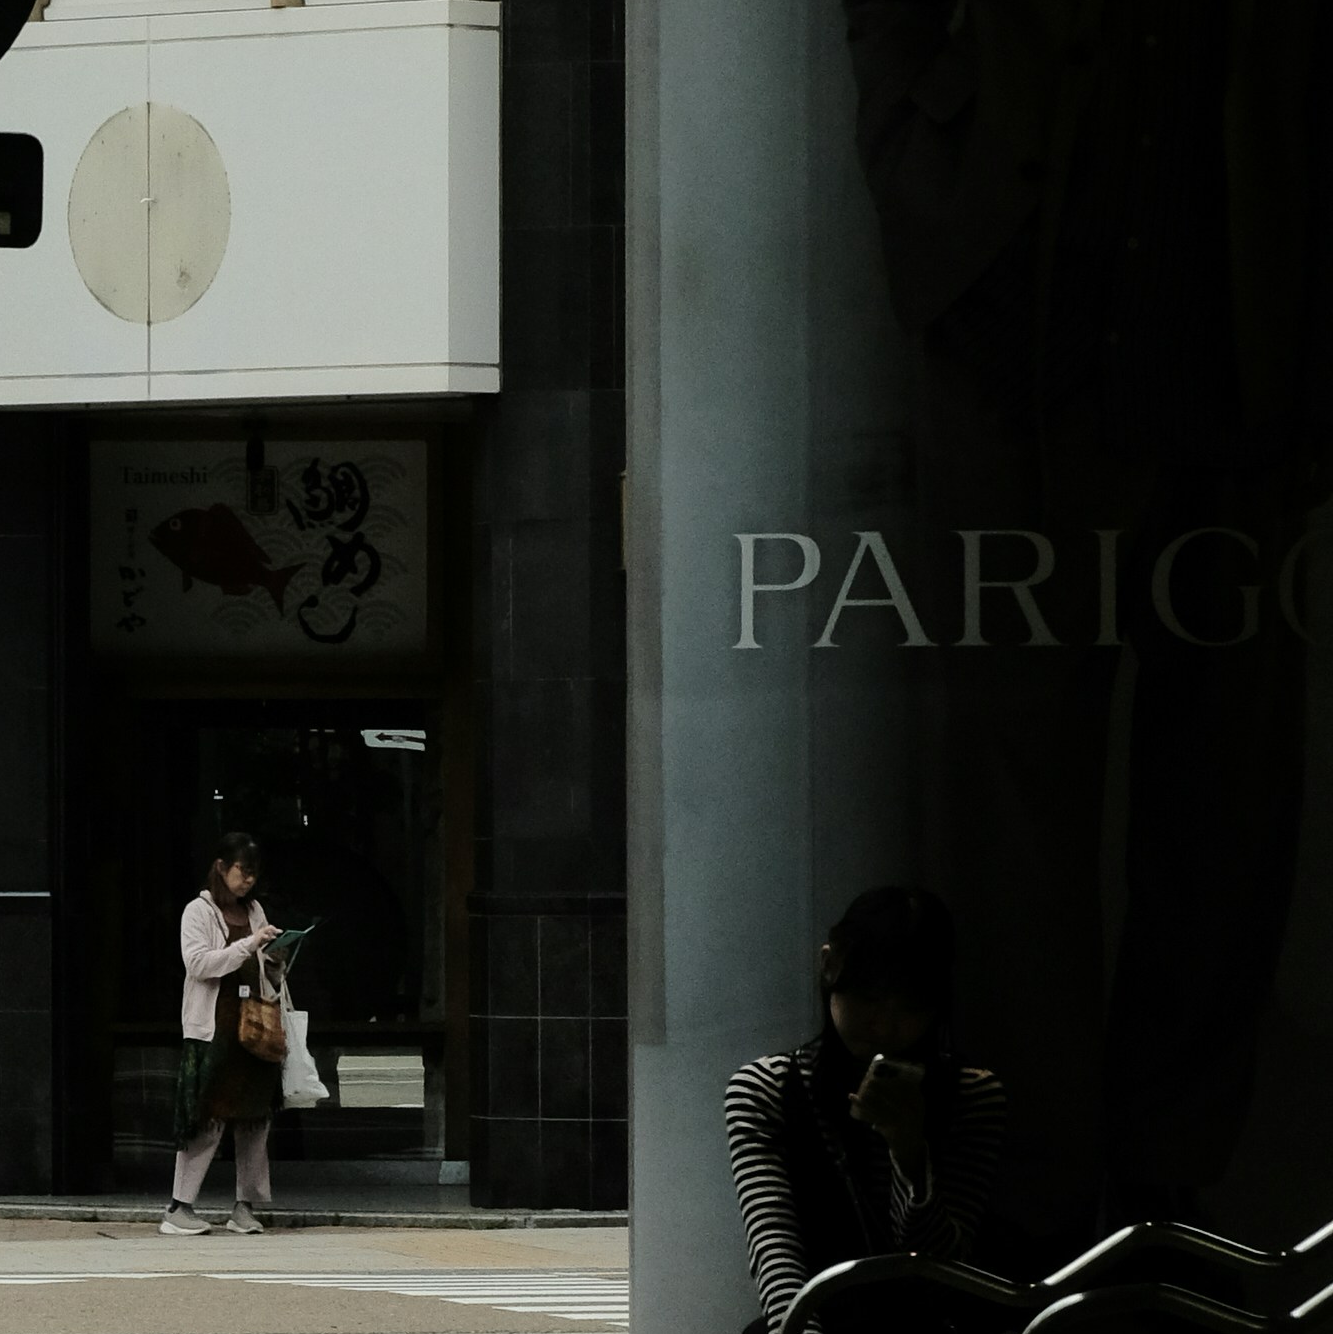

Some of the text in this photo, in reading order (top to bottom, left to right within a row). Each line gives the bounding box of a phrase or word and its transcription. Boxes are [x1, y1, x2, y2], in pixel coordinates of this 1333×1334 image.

[121, 466, 209, 485] Taimeshi
[286, 458, 381, 644] 鯛めし
[117, 567, 146, 633] かどや
